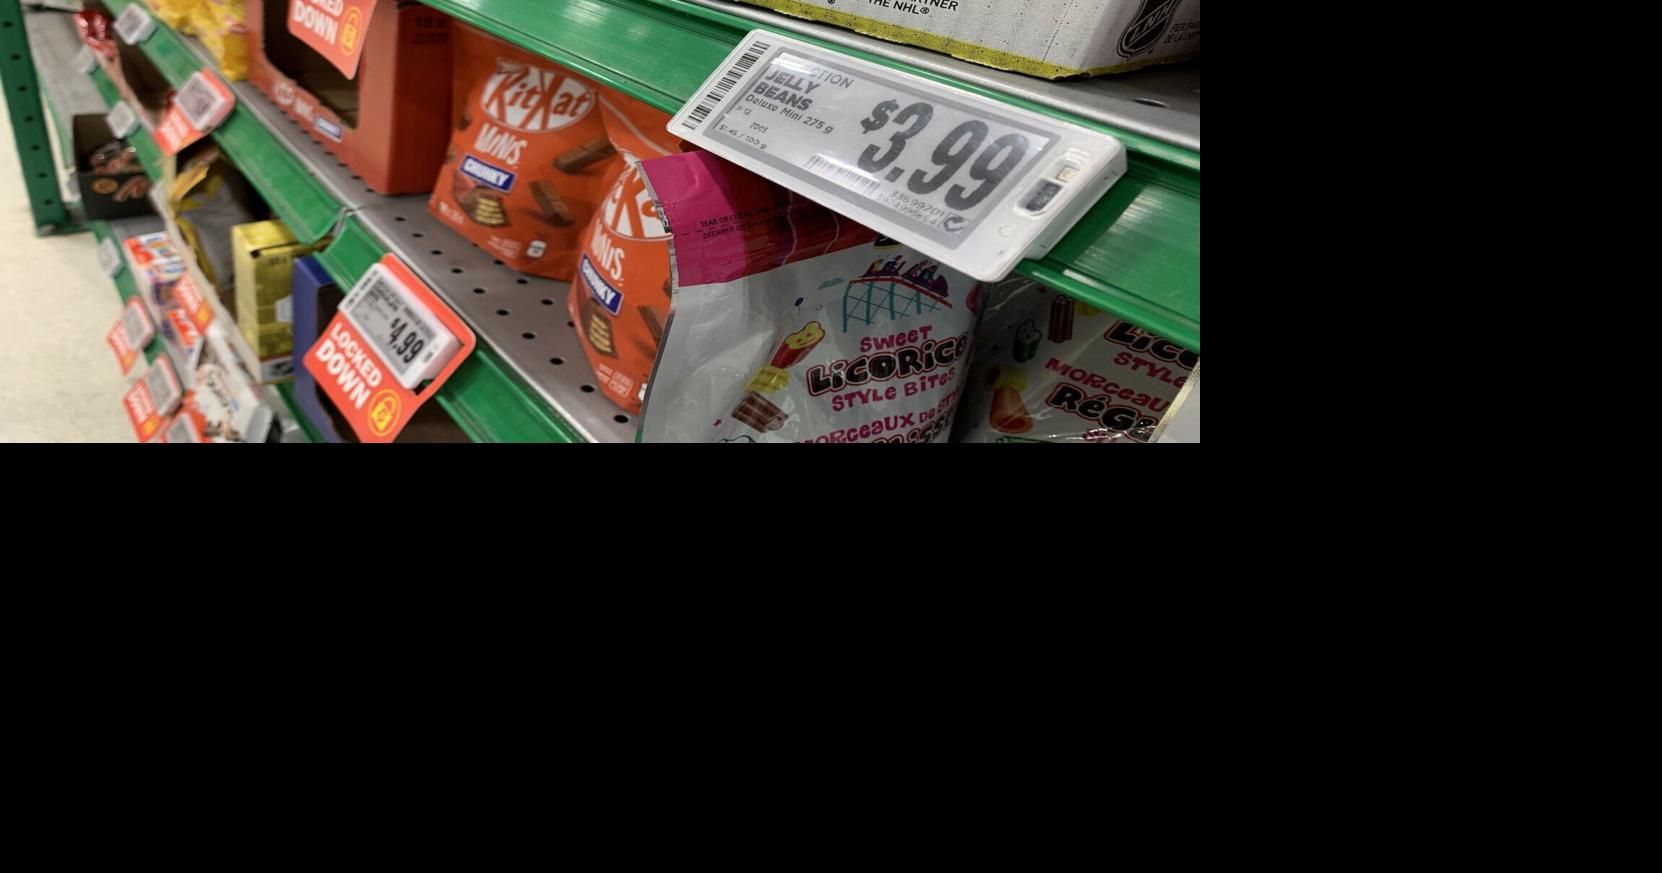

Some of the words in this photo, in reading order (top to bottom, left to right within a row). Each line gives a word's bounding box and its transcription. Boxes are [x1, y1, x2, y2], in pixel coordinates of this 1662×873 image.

[293, 0, 339, 45] DOWN
[753, 82, 814, 110] BEANS
[765, 69, 821, 94] JELLY
[745, 94, 778, 112] Deluxe
[780, 107, 802, 121] Mini
[803, 115, 824, 130] 275
[823, 125, 835, 134] g
[473, 122, 528, 165] MINIS
[744, 135, 760, 146] 100
[857, 98, 1030, 211] $3.99
[330, 322, 383, 388] LOCKED
[387, 317, 425, 364] $4.99
[315, 339, 372, 409] DOWN
